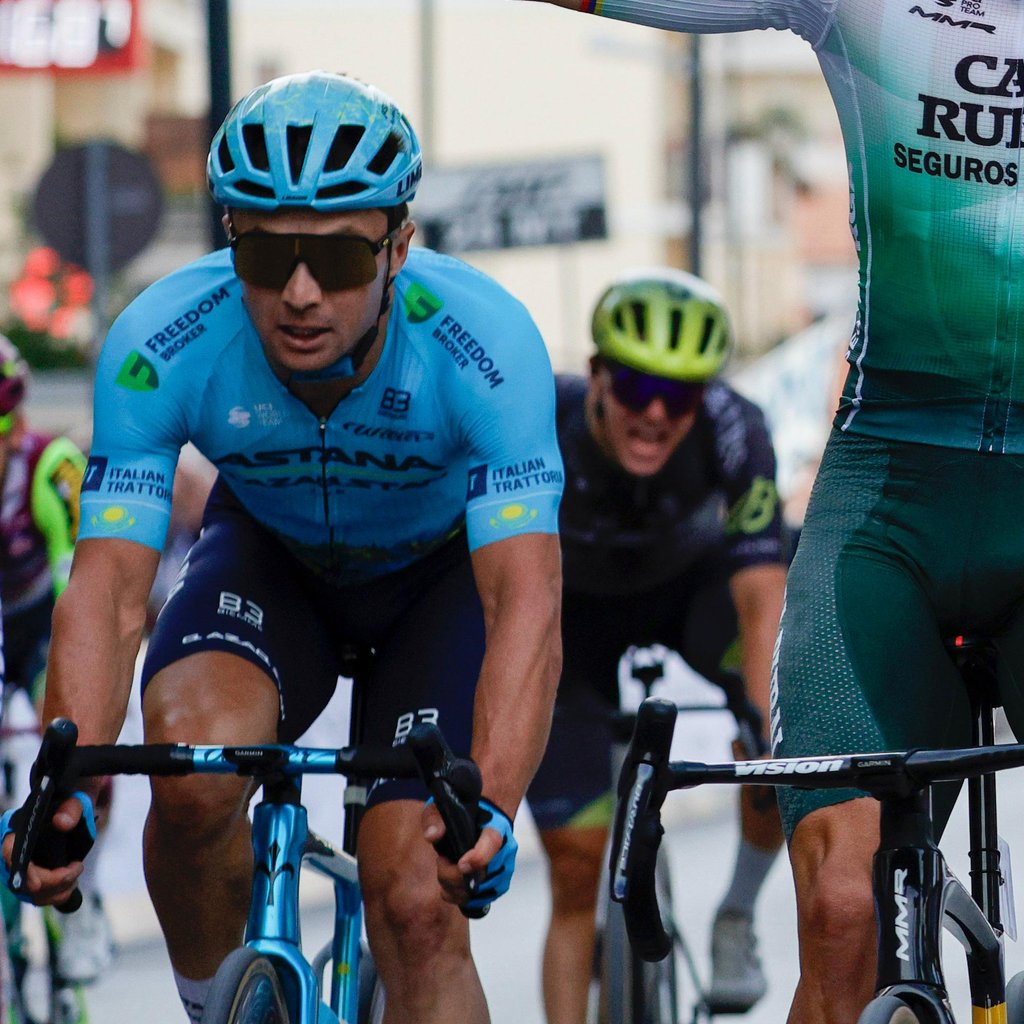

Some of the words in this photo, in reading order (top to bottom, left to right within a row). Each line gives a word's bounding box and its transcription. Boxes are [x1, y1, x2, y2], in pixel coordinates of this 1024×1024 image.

[960, 5, 985, 17] TEAM
[961, 0, 981, 10] PRO
[893, 142, 1018, 187] SEGUROS
[145, 287, 231, 353] FREEDOM
[160, 323, 208, 362] BROKER
[431, 327, 469, 370] BROKER
[440, 314, 505, 390] FREEDOM
[214, 446, 448, 471] ASTANA
[492, 457, 546, 481] ITALIAN
[109, 467, 165, 484] ITALIAN
[857, 760, 891, 768] GARMIN
[894, 868, 910, 962] MMR
